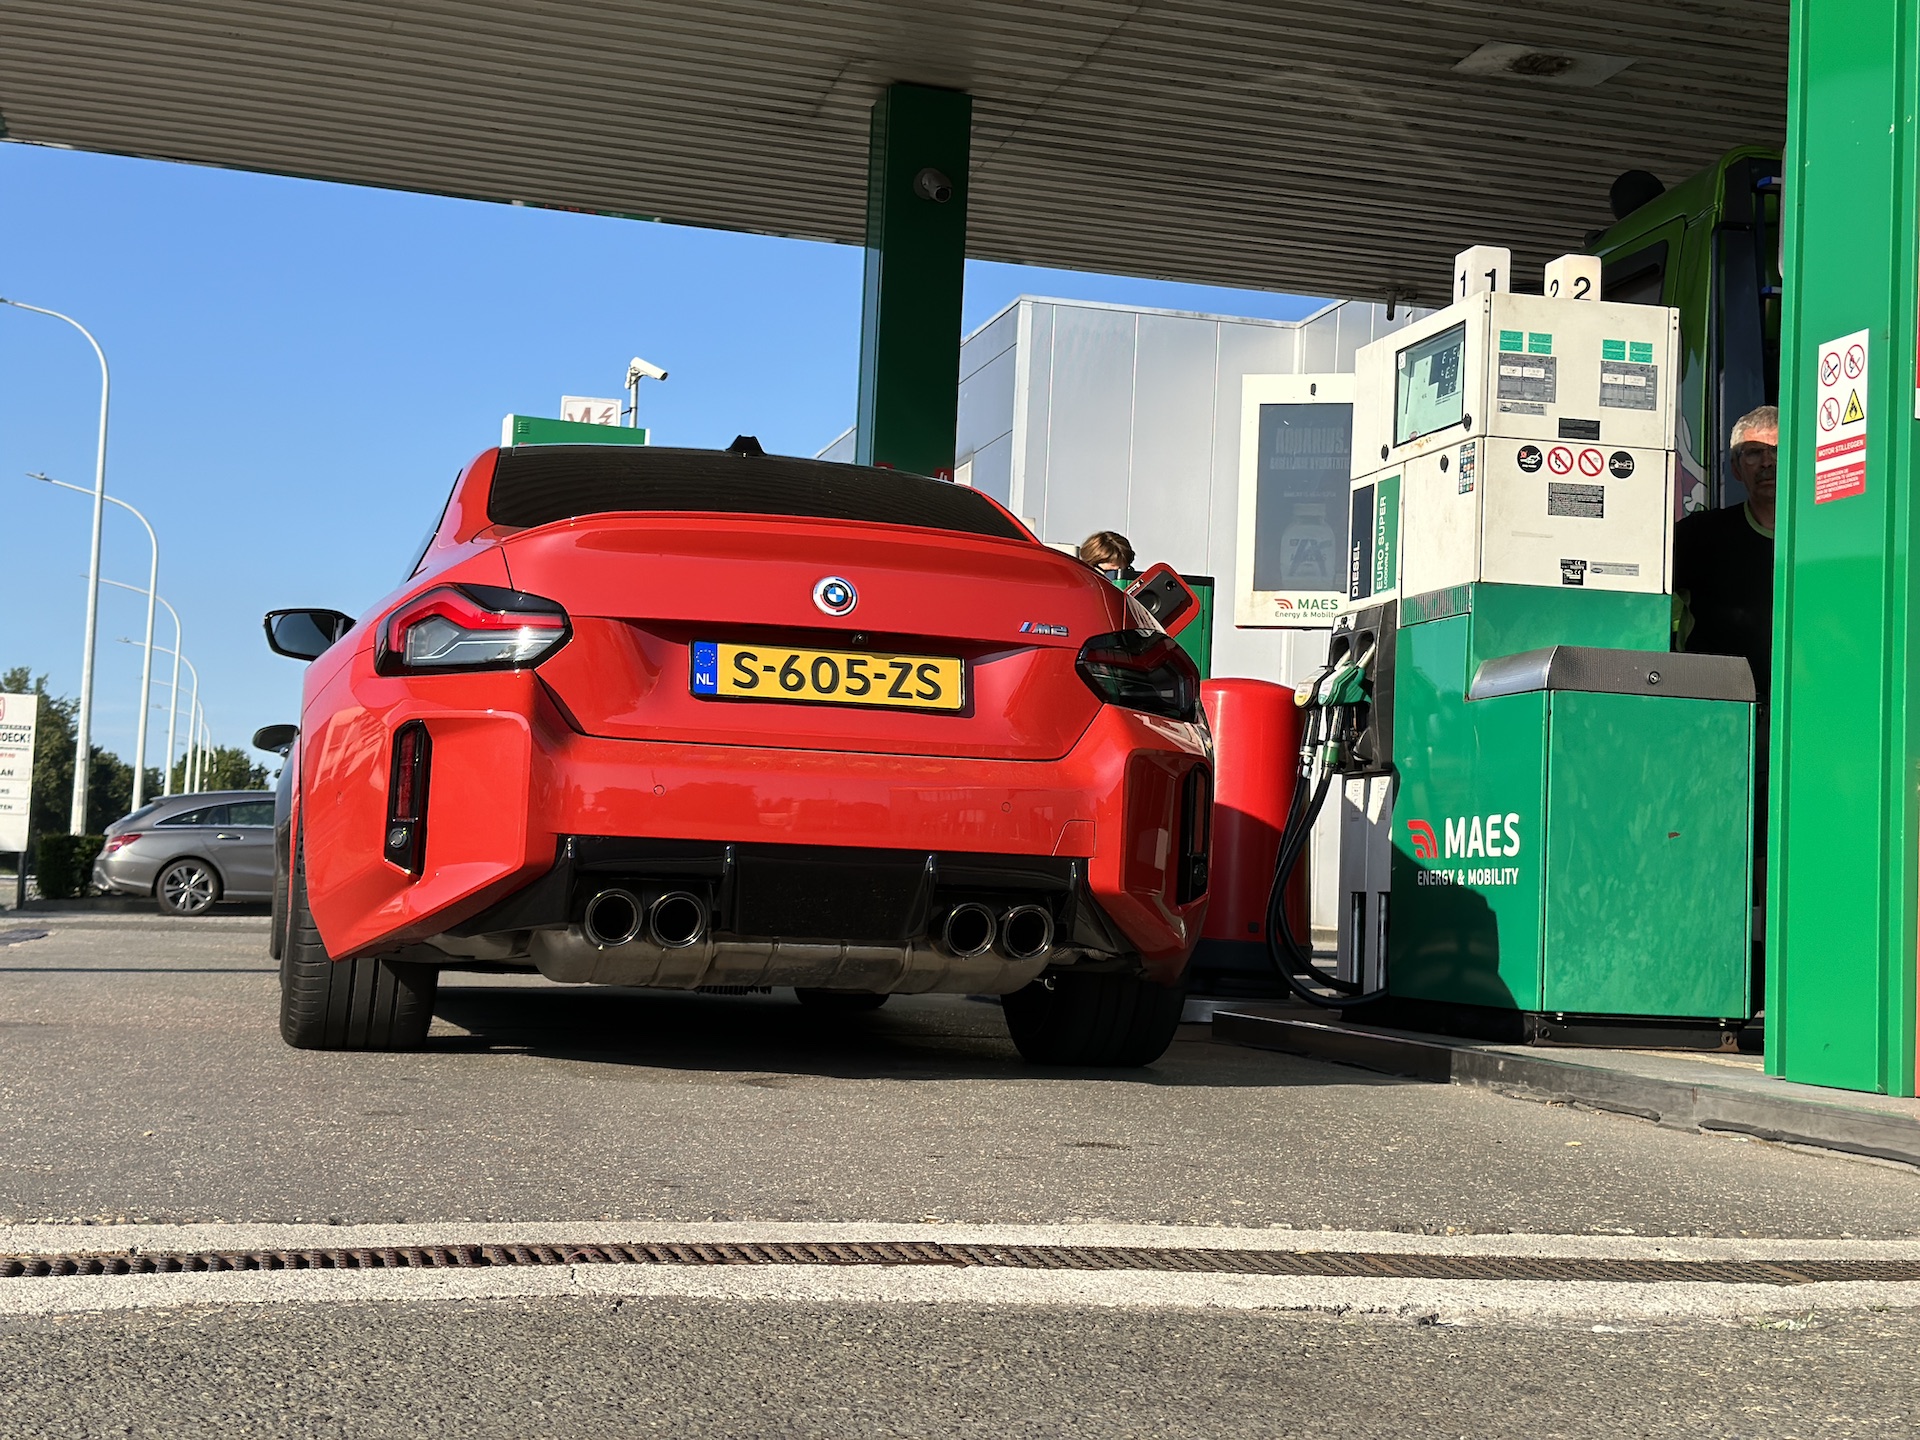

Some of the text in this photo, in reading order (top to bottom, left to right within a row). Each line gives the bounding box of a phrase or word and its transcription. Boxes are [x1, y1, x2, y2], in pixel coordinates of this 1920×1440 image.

[1460, 269, 1467, 298] 1
[1484, 268, 1497, 292] 1
[1573, 276, 1592, 300] 2
[1818, 447, 1835, 457] MOTOR
[1376, 495, 1387, 590] EURO SUPER
[1351, 540, 1361, 598] DIESEL
[1274, 610, 1301, 619] Energy
[1297, 598, 1339, 610] MAES
[1032, 622, 1069, 637] M2
[695, 650, 942, 701] NL S-605-ZS
[1445, 812, 1521, 859] MAES
[1417, 867, 1519, 886] ENERGY & MOBILITY
